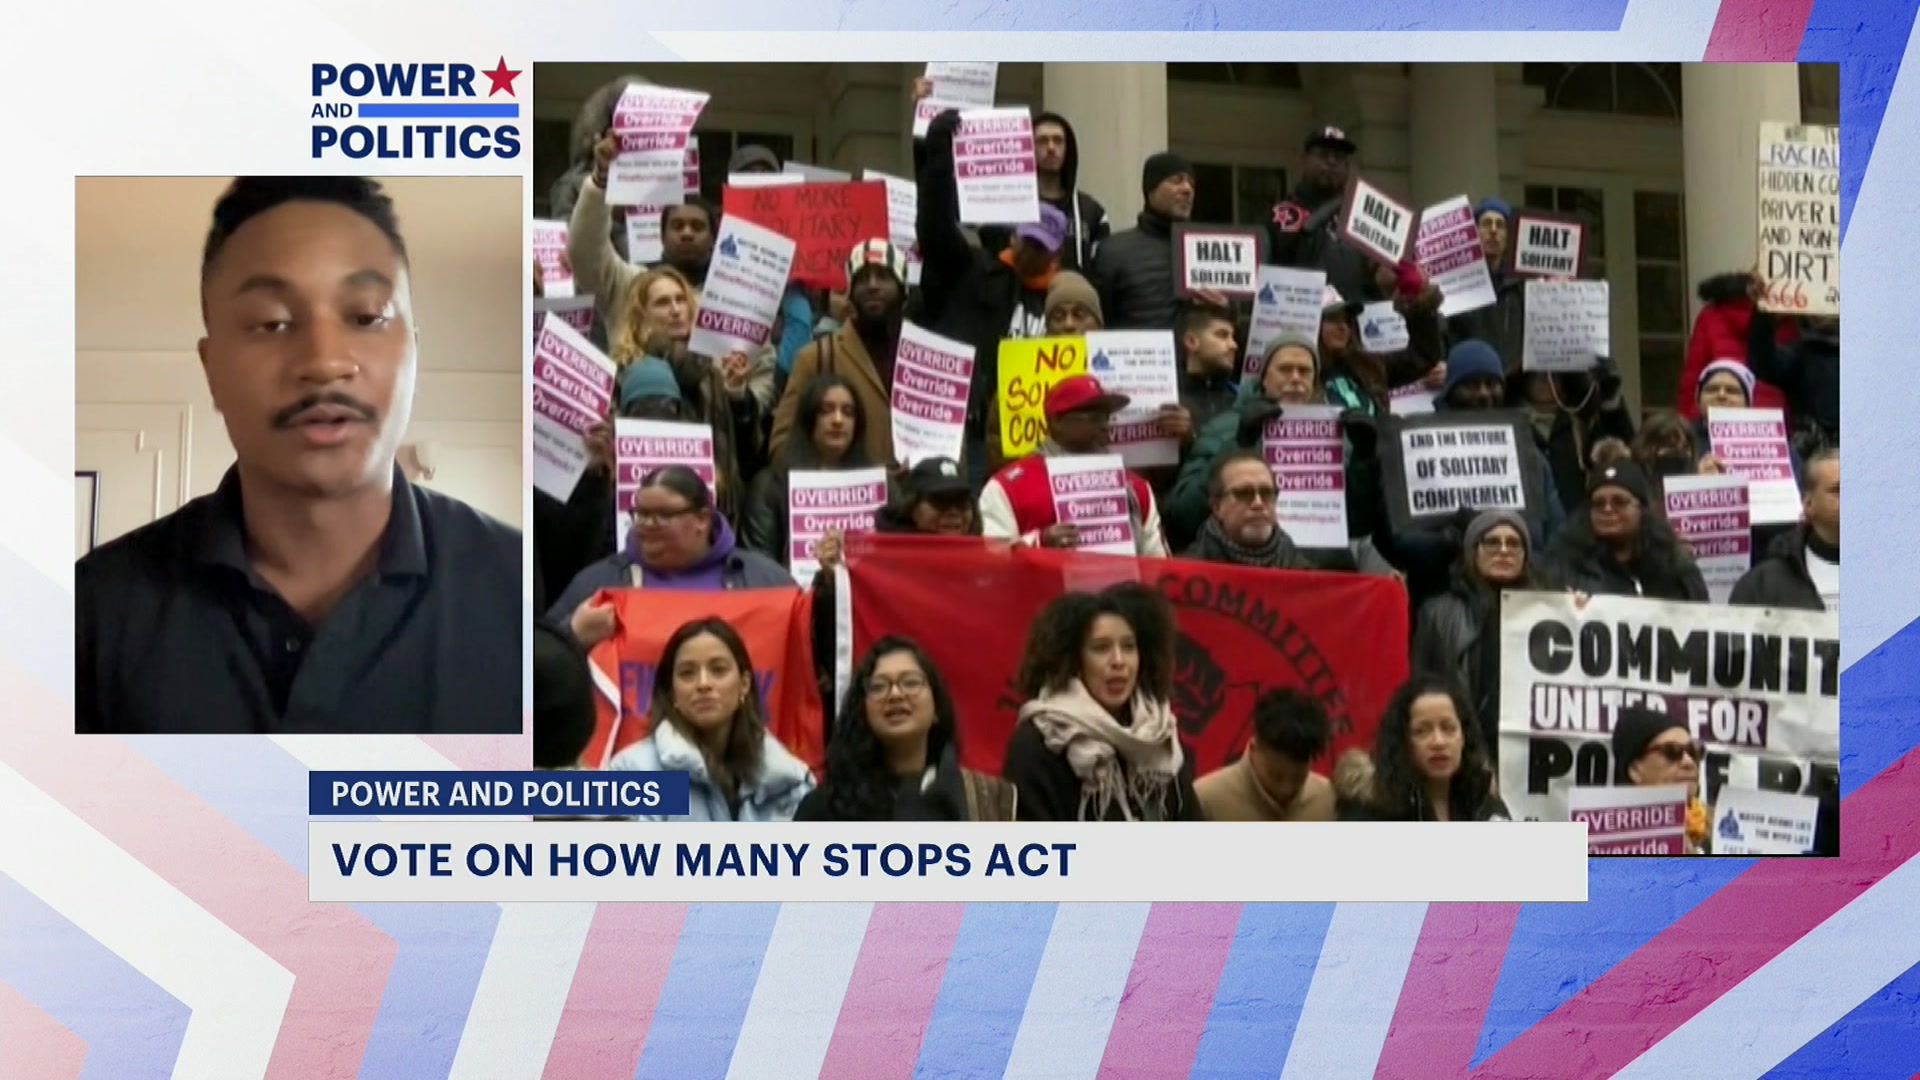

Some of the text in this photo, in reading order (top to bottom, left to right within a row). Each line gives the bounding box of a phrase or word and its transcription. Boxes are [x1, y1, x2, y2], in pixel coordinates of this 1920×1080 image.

[622, 133, 676, 150] Override
[965, 138, 1023, 154] Override
[1771, 144, 1839, 167] RACIAL
[967, 159, 1025, 175] Override
[1761, 172, 1814, 193] HIDDEN
[1364, 194, 1401, 233] HALT
[1761, 198, 1823, 224] DRIVER
[1352, 217, 1399, 257] SOLITARY
[1529, 225, 1570, 250] HALT
[1761, 227, 1791, 245] AND
[1196, 241, 1242, 262] HALT
[1520, 252, 1573, 272] SOLITARY
[1768, 250, 1834, 282] DIRT
[1190, 268, 1251, 286] SOLITARY
[543, 333, 607, 388] OVERRIDE
[901, 340, 963, 376] OVERRIDE
[1035, 344, 1077, 374] NO
[541, 363, 600, 408] Override
[902, 369, 957, 396] Override
[898, 393, 953, 421] Override
[1267, 421, 1337, 438] OVERRIDE
[1713, 422, 1778, 439] OVERRIDE
[621, 437, 702, 457] OVERRIDE
[1275, 446, 1333, 463] Override
[1723, 443, 1779, 458] Override
[1416, 455, 1508, 479] OF SOLITARY
[1055, 470, 1119, 492] OVERRIDE
[1276, 472, 1334, 490] Override
[795, 485, 878, 506] OVERRIDE
[1413, 484, 1518, 511] CONFINEMENT
[1670, 489, 1743, 510] OVERRIDE
[1068, 499, 1119, 518] Override
[804, 513, 875, 532] Override
[1680, 515, 1739, 533] Override
[1081, 525, 1122, 545] verride
[1693, 538, 1739, 556] verride
[1688, 697, 1763, 746] FOR
